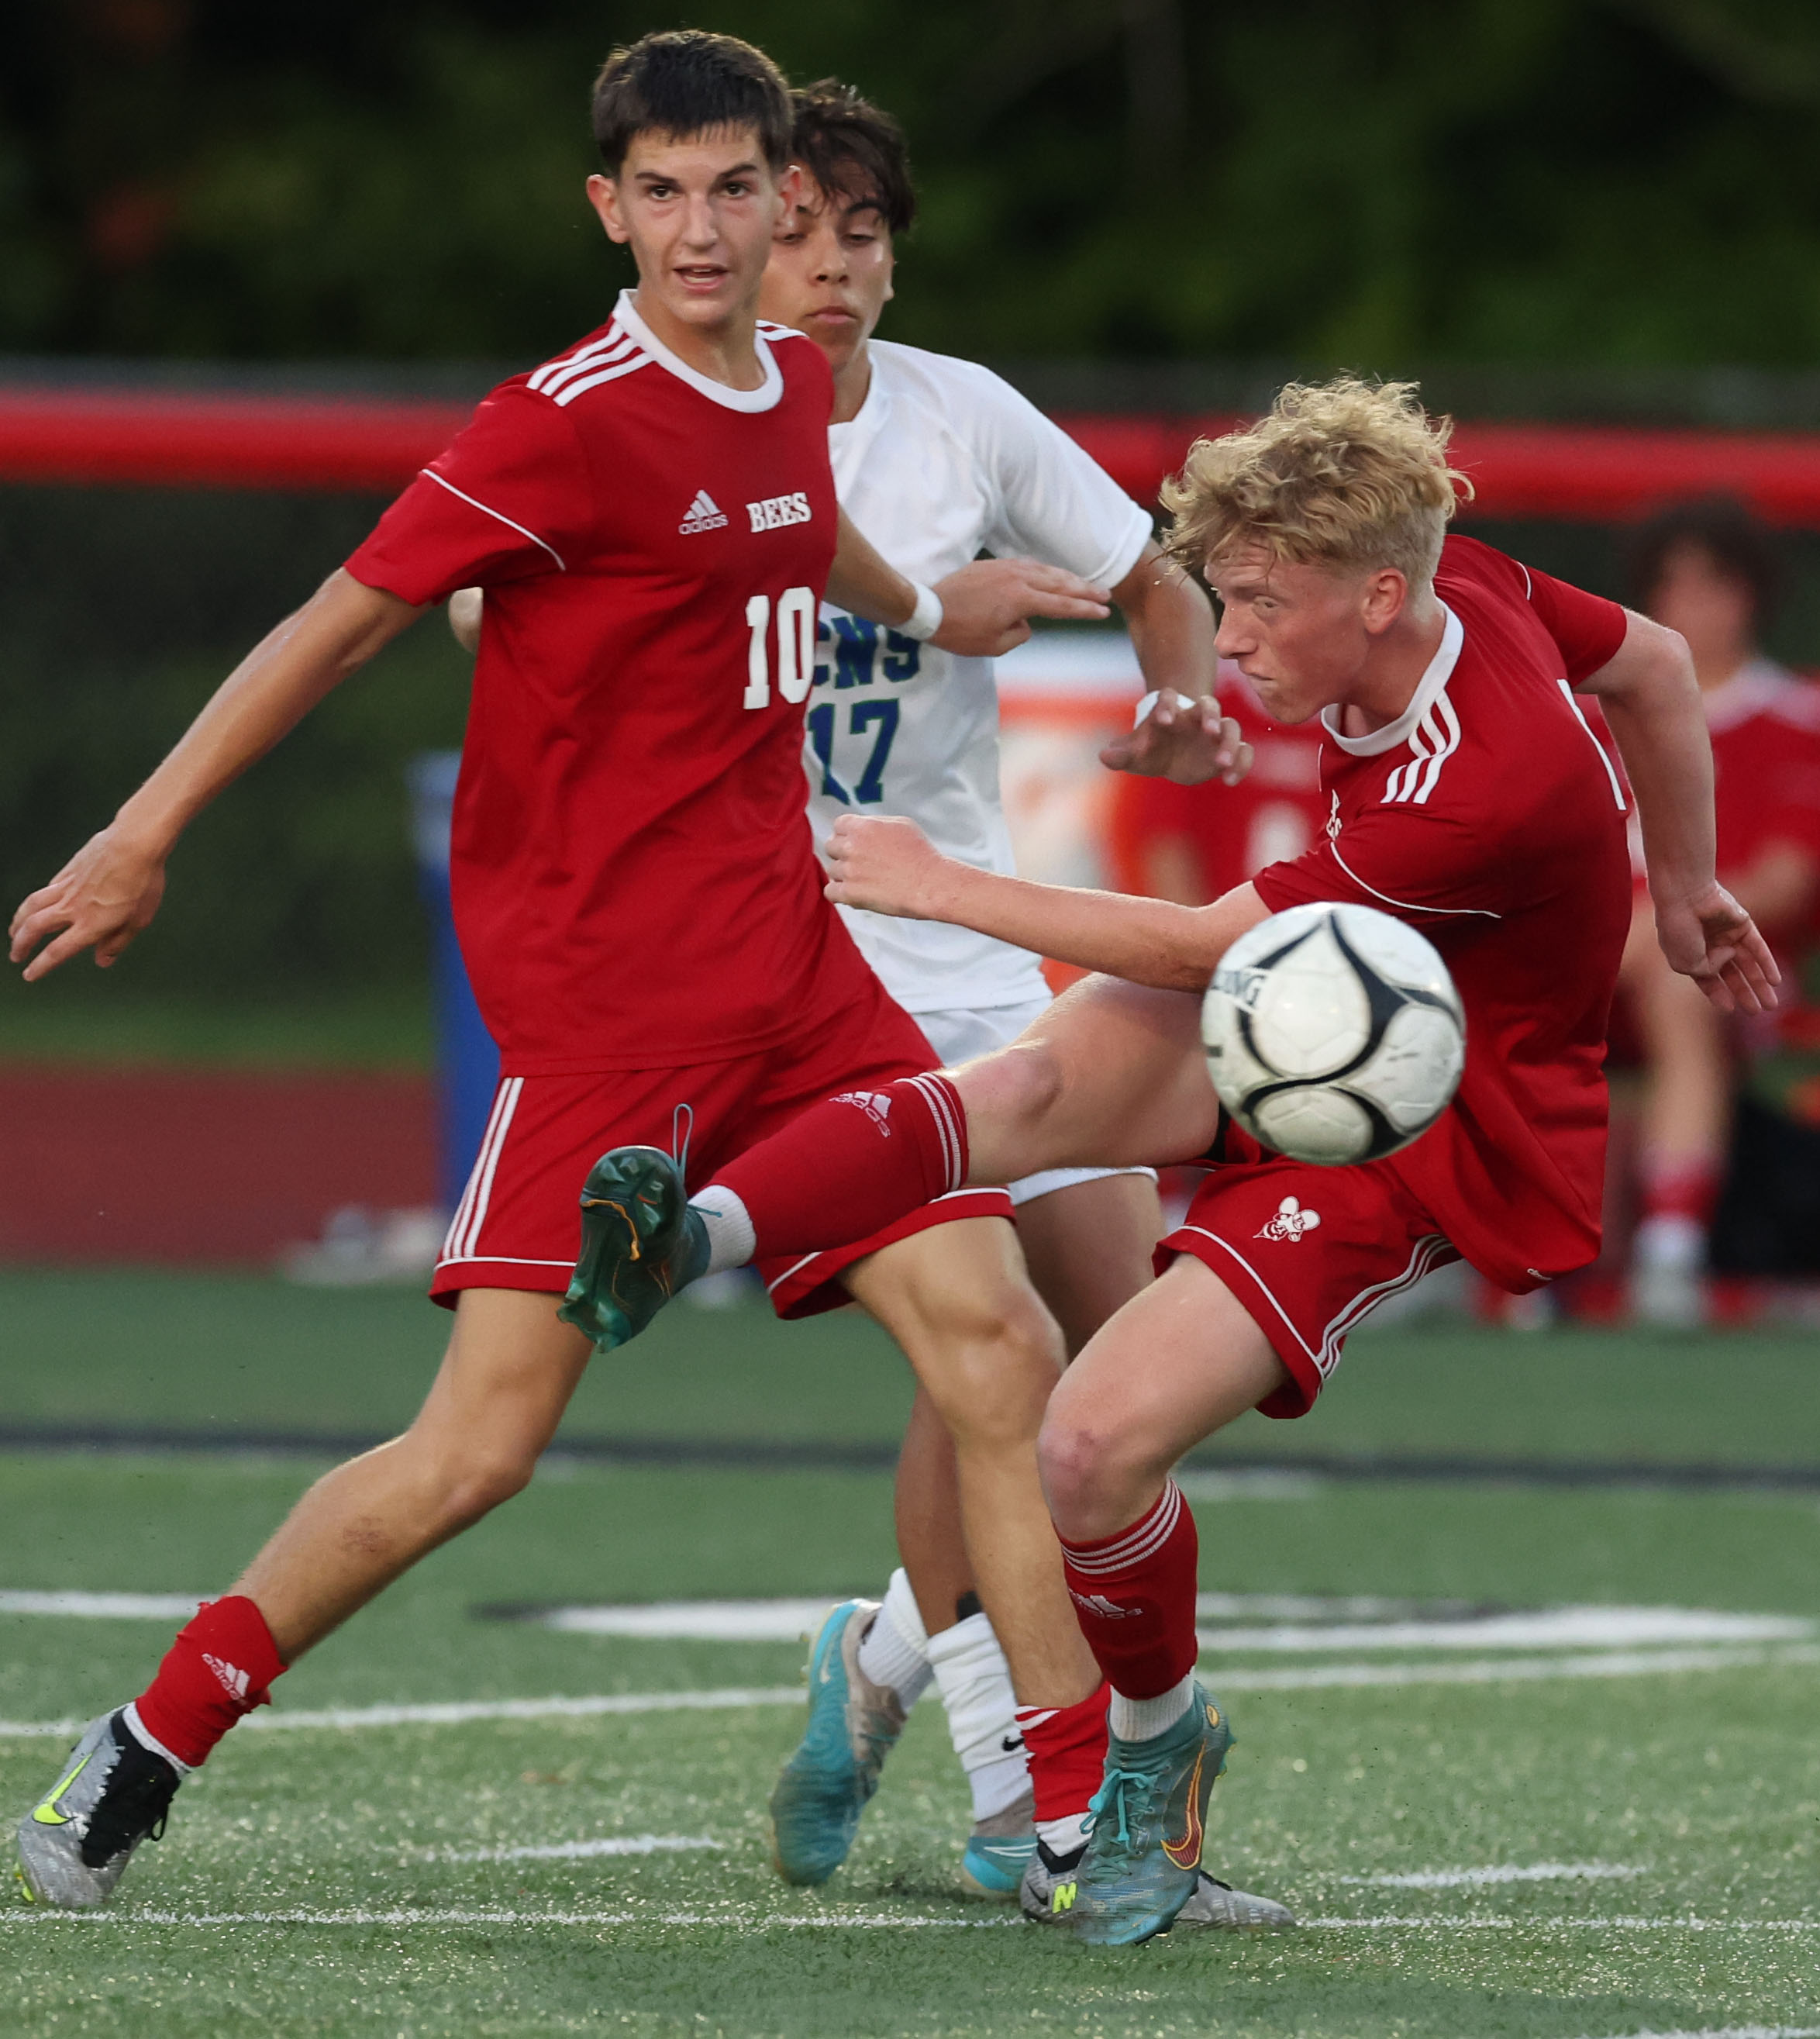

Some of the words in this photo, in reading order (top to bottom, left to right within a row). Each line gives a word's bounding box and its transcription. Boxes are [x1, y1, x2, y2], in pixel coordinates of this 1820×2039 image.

[746, 492, 812, 533] BEES
[743, 586, 815, 709] 10
[808, 698, 900, 806] 17
